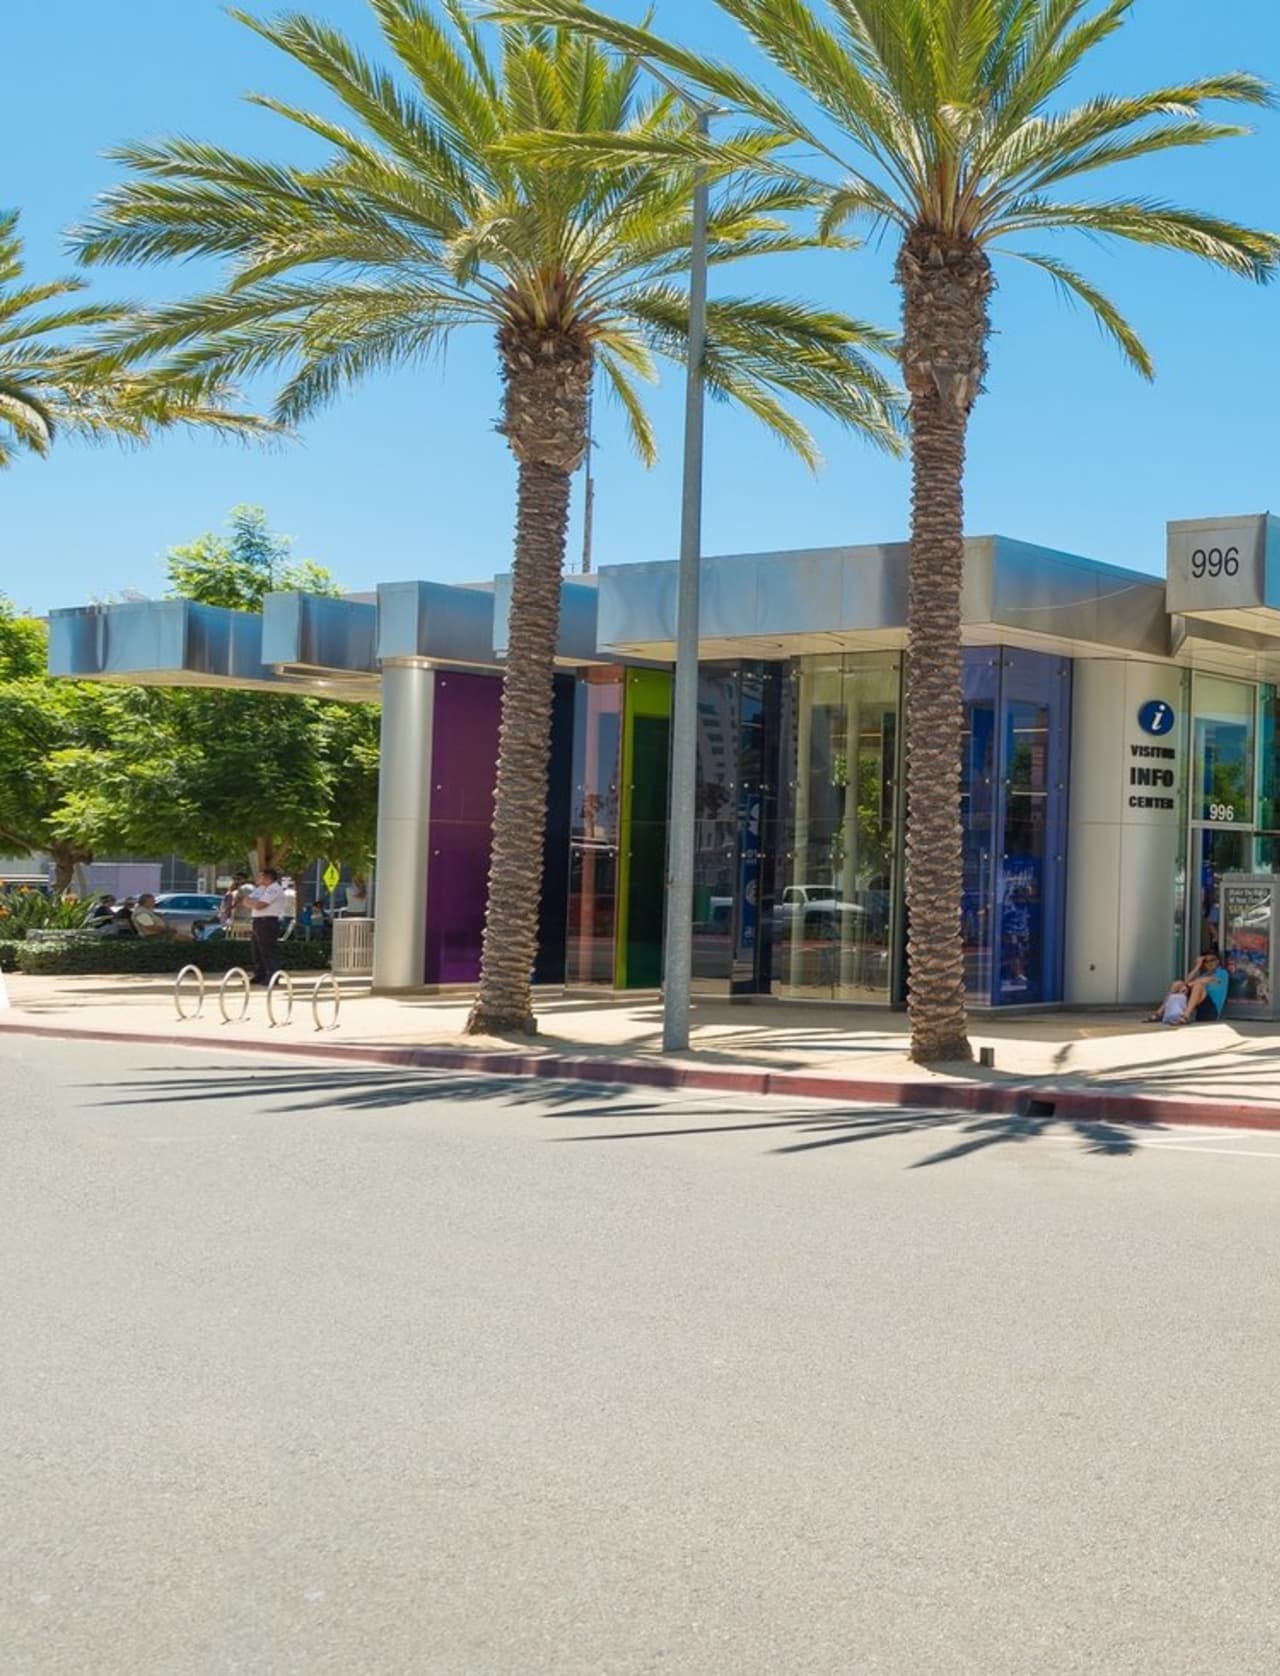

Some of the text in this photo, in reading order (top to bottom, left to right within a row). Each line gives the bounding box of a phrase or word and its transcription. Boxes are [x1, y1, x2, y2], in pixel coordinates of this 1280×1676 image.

[1191, 546, 1239, 578] 996
[1130, 767, 1174, 787] INFO
[1129, 796, 1174, 809] CENTER
[1209, 804, 1234, 821] 996
